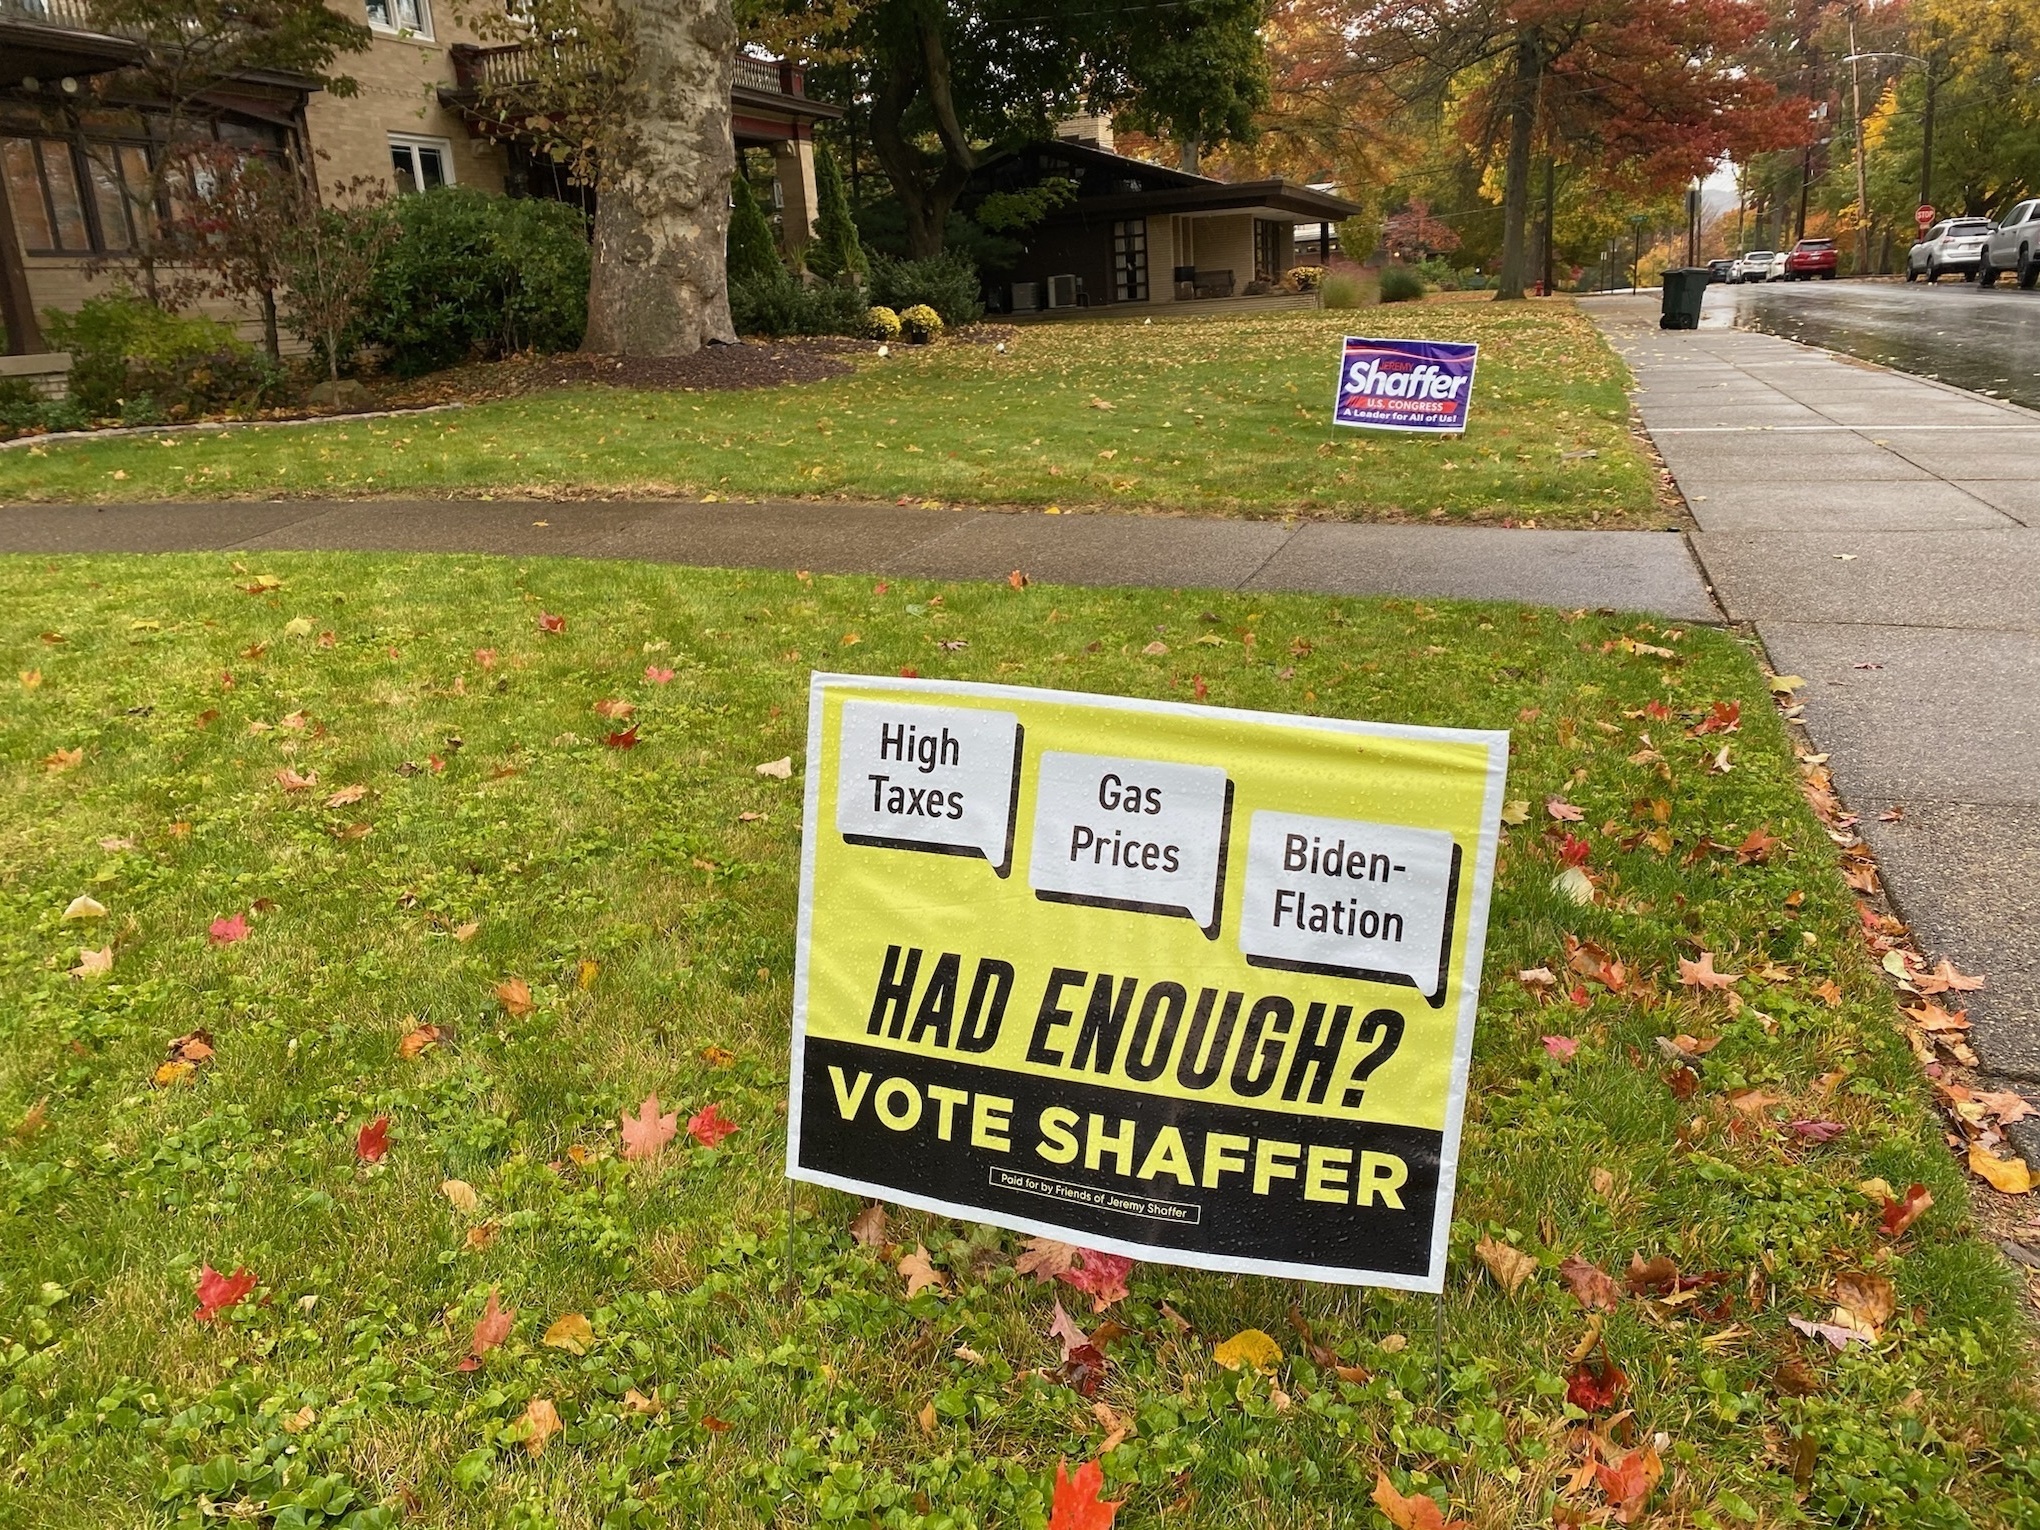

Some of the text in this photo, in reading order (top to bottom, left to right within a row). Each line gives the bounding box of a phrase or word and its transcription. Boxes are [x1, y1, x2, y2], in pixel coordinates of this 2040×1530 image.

[1917, 211, 1934, 219] STOP
[1344, 358, 1468, 400] Shaffer
[1380, 361, 1414, 371] JEREMY
[1354, 410, 1390, 420] Leader
[1392, 411, 1408, 420] for
[1409, 414, 1424, 422] All
[1426, 414, 1439, 422] of
[1368, 399, 1444, 412] U.S. CONGRESS
[880, 722, 959, 773] High
[868, 774, 964, 820] Taxes
[1099, 773, 1162, 815] Gas
[1069, 825, 1180, 873] Prices
[1284, 834, 1407, 884] Biden-
[1272, 889, 1404, 942] Flation
[866, 945, 1406, 1108] HAD ENOUGH?
[828, 1065, 1408, 1211] VOTE SHAFFER
[1001, 1174, 1187, 1218] Paid for by Friends of Jeremy Shaffer
